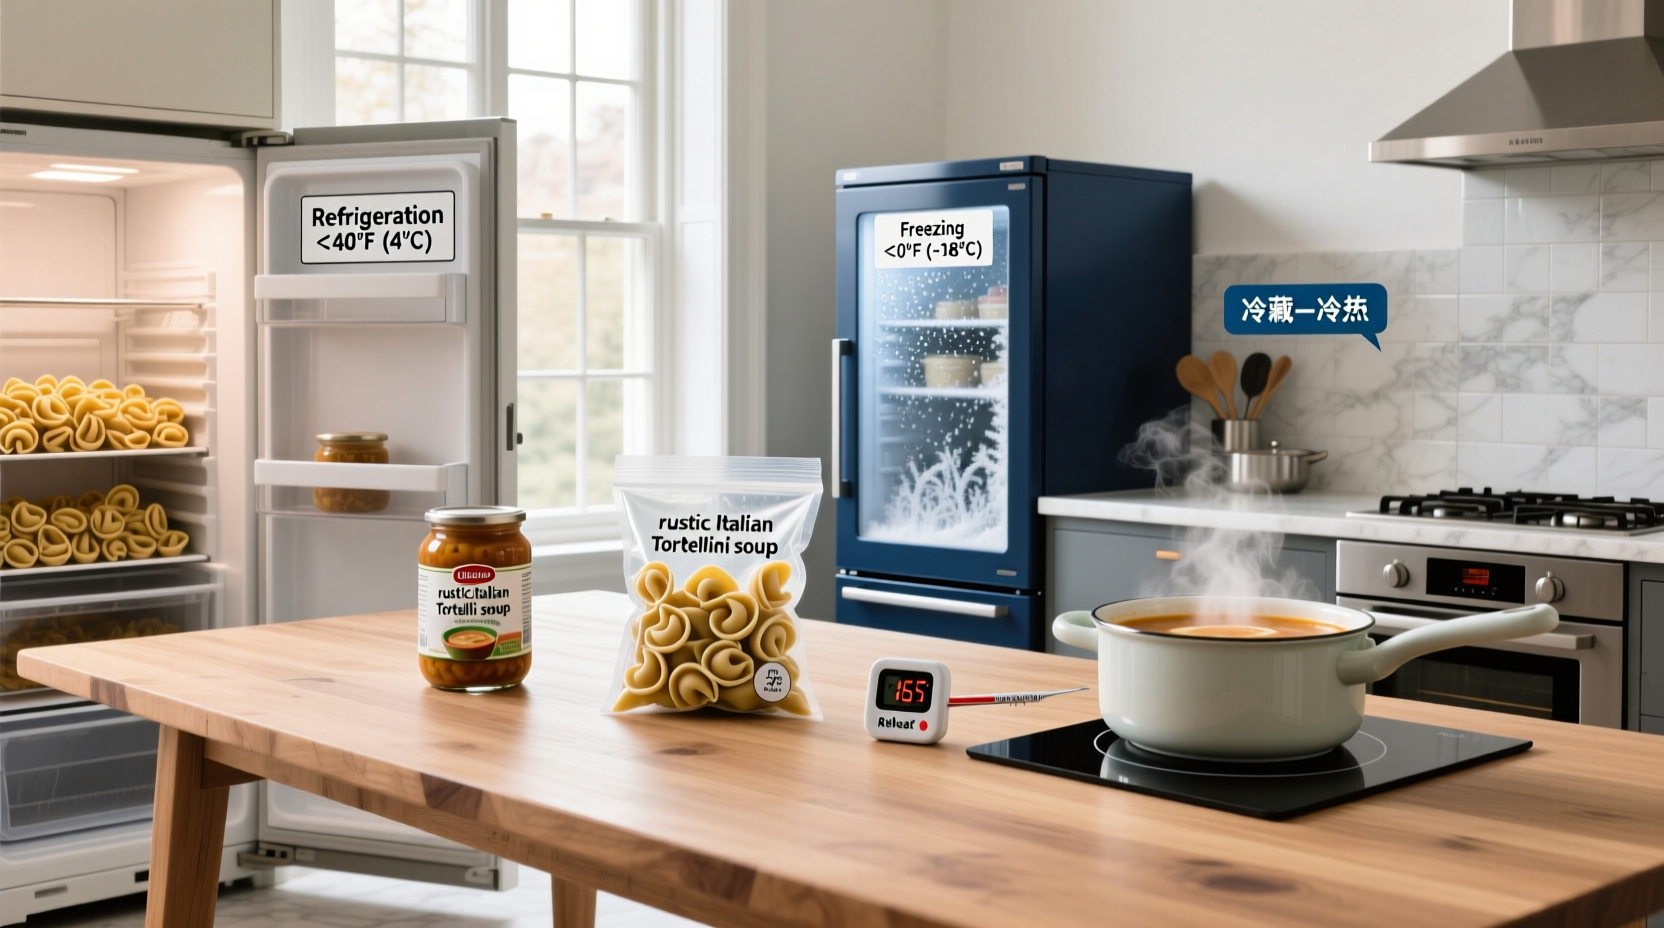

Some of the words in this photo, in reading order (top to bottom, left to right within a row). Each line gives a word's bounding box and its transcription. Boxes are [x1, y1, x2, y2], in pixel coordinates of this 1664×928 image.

[312, 204, 444, 231] Refrigeration
[900, 219, 965, 240] Freezing
[659, 514, 711, 530] rustic
[716, 514, 773, 533] Italian
[651, 535, 730, 554] Tortellini
[733, 541, 778, 559] soup
